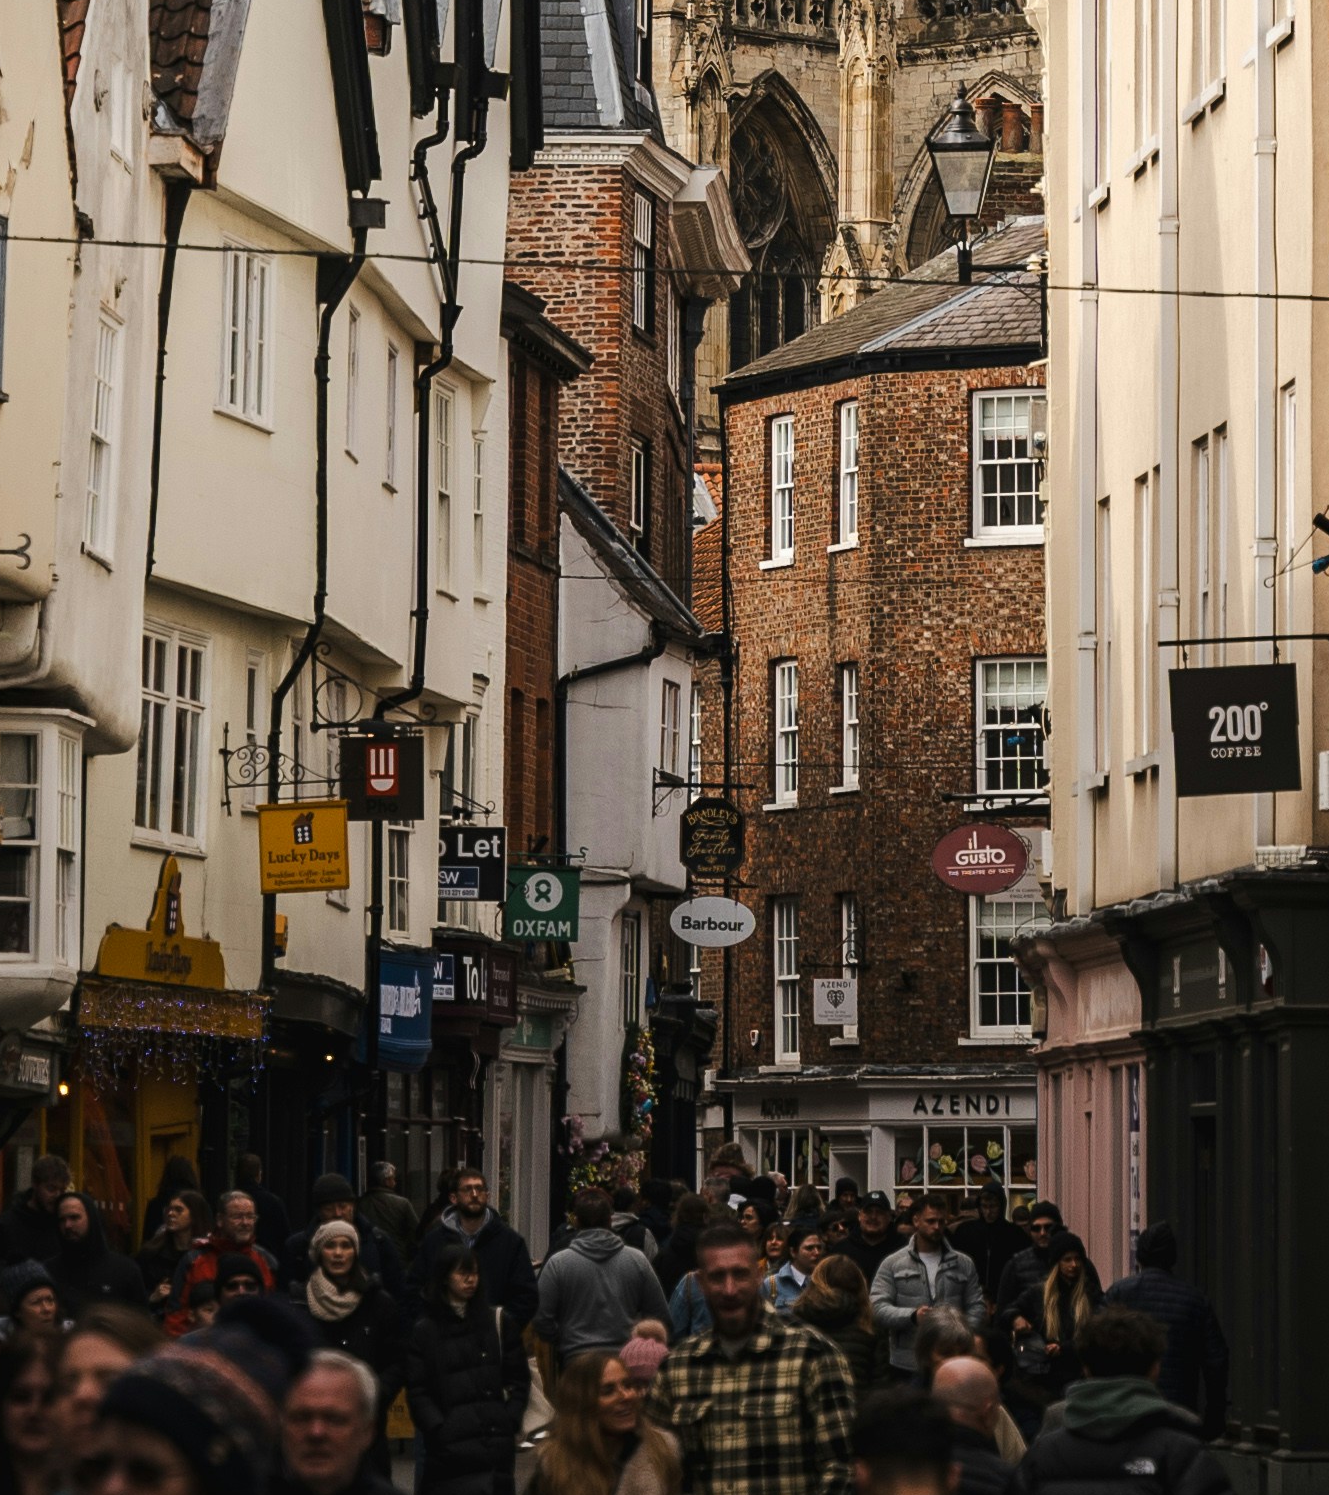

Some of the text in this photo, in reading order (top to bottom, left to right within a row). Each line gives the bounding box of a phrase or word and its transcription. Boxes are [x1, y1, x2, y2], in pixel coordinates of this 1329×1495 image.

[1210, 746, 1262, 759] COFFEE
[457, 833, 501, 859] Let
[268, 848, 340, 865] Lucky Days
[513, 919, 571, 938] OXFAM
[681, 915, 744, 932] Barbour
[463, 956, 479, 1000] To
[821, 981, 851, 989] AZENDI
[912, 1094, 1011, 1116] AZENDI
